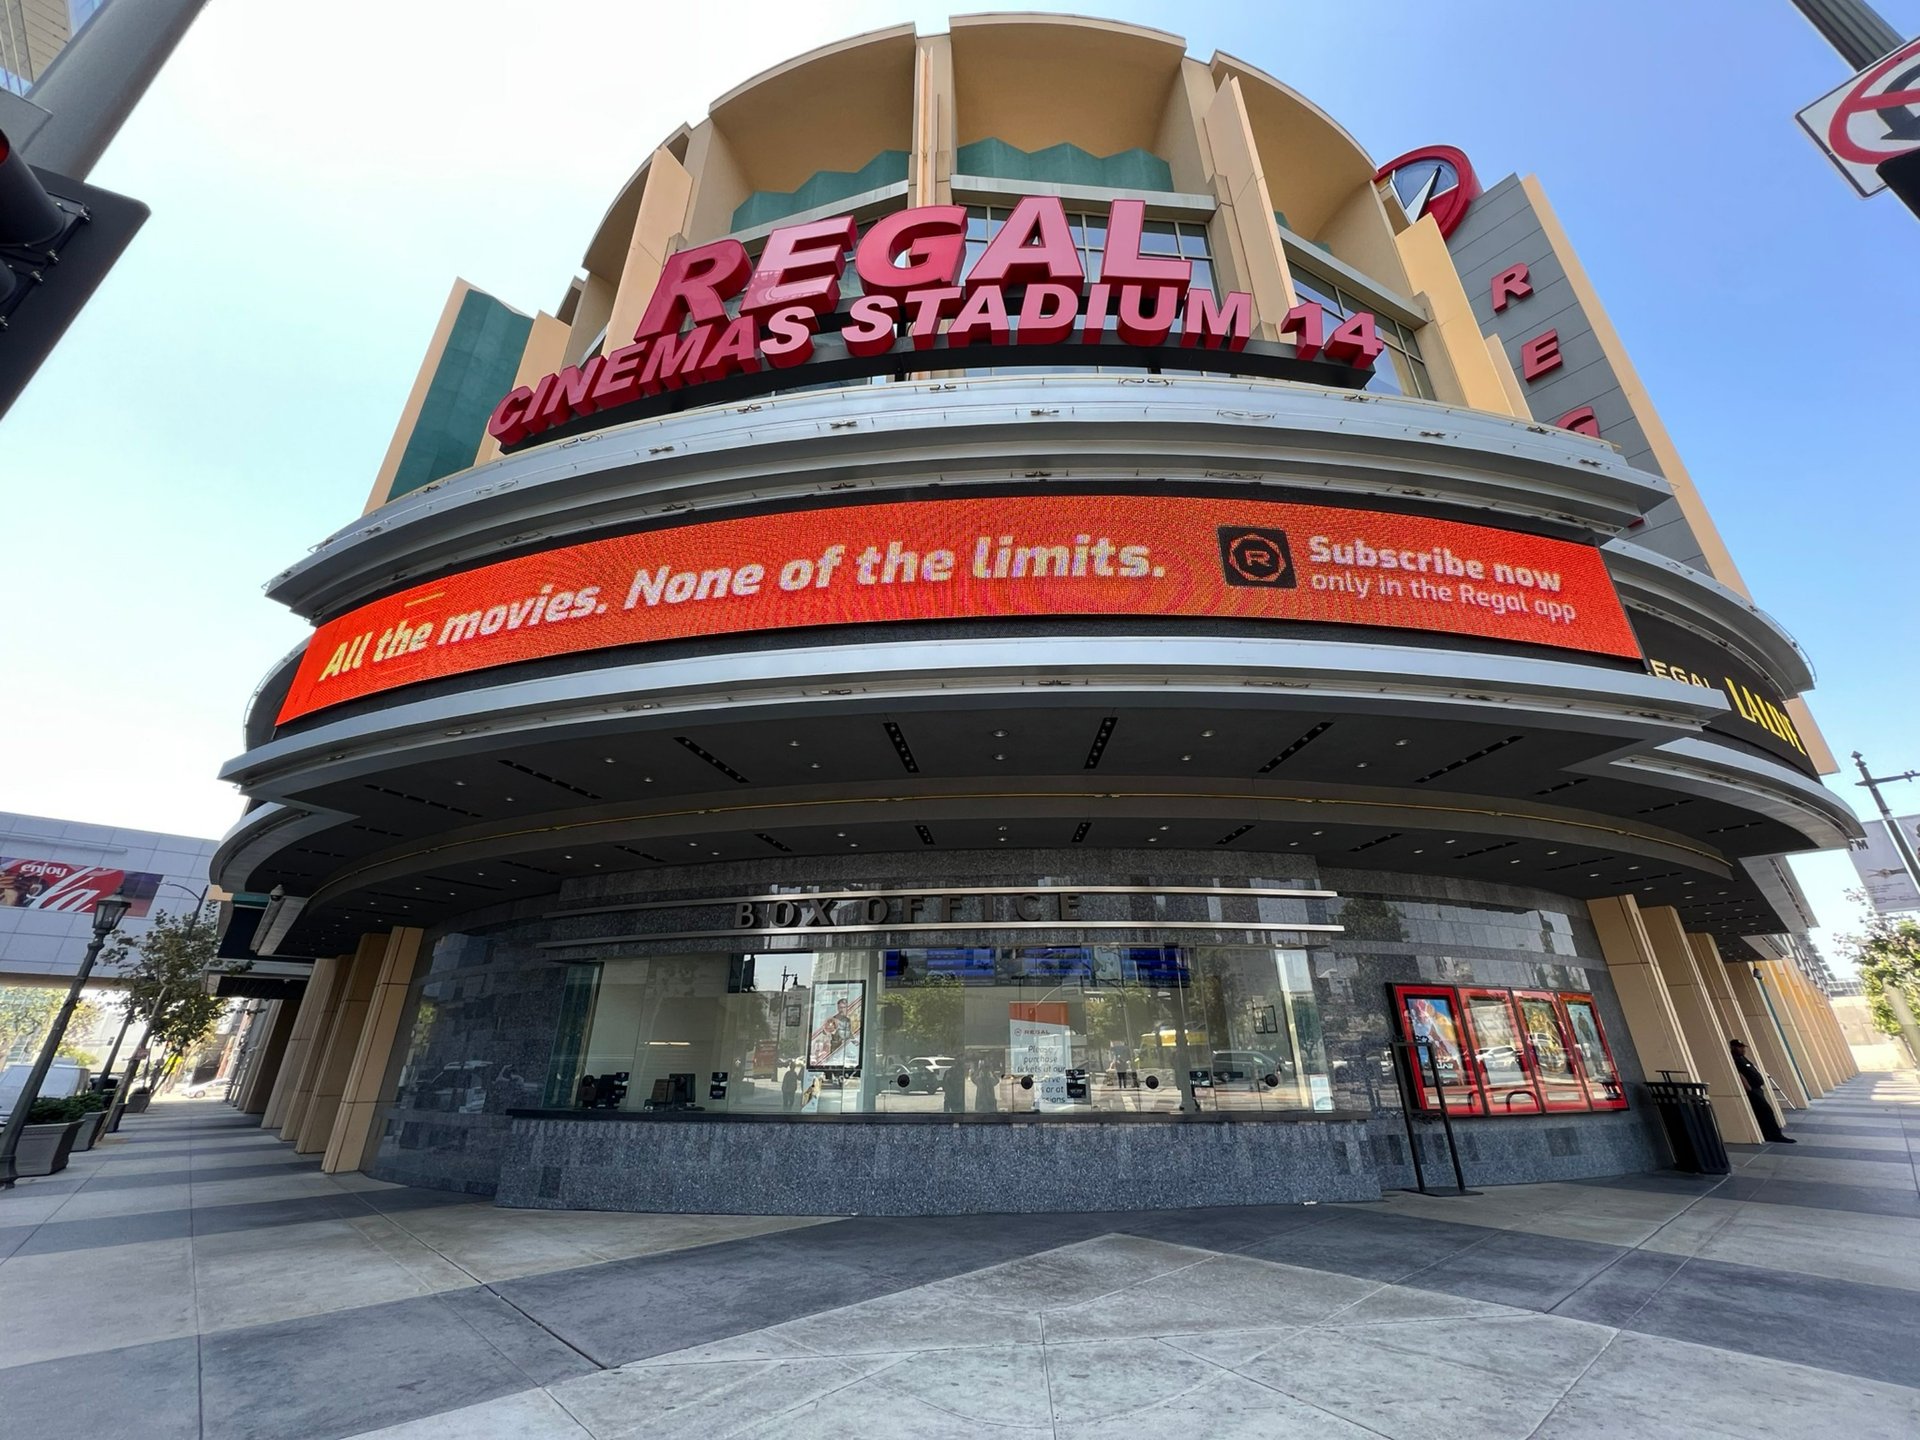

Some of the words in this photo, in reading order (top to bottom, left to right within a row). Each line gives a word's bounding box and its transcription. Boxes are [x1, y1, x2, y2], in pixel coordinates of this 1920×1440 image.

[635, 196, 1192, 341] REGAL
[488, 306, 820, 446] CINEMAS
[842, 284, 1252, 357] STADIUM
[1282, 302, 1384, 369] 14
[1308, 535, 1485, 580] Subscribe
[1494, 561, 1562, 592] now
[318, 631, 372, 682] All
[372, 620, 434, 663] the
[437, 584, 606, 645] movies.
[624, 564, 765, 610] None
[779, 544, 846, 591] of
[856, 541, 954, 585] the
[972, 534, 1165, 579] limits.
[1311, 571, 1371, 598] only
[1379, 574, 1402, 596] in
[1410, 578, 1452, 602] the
[1459, 586, 1529, 615] Regal
[1534, 598, 1576, 623] app
[21, 863, 67, 878] enjoy
[733, 899, 834, 928] BOX
[862, 894, 1082, 924] OFFICE
[1017, 1064, 1041, 1073] tickets
[1023, 1055, 1058, 1065] purchase
